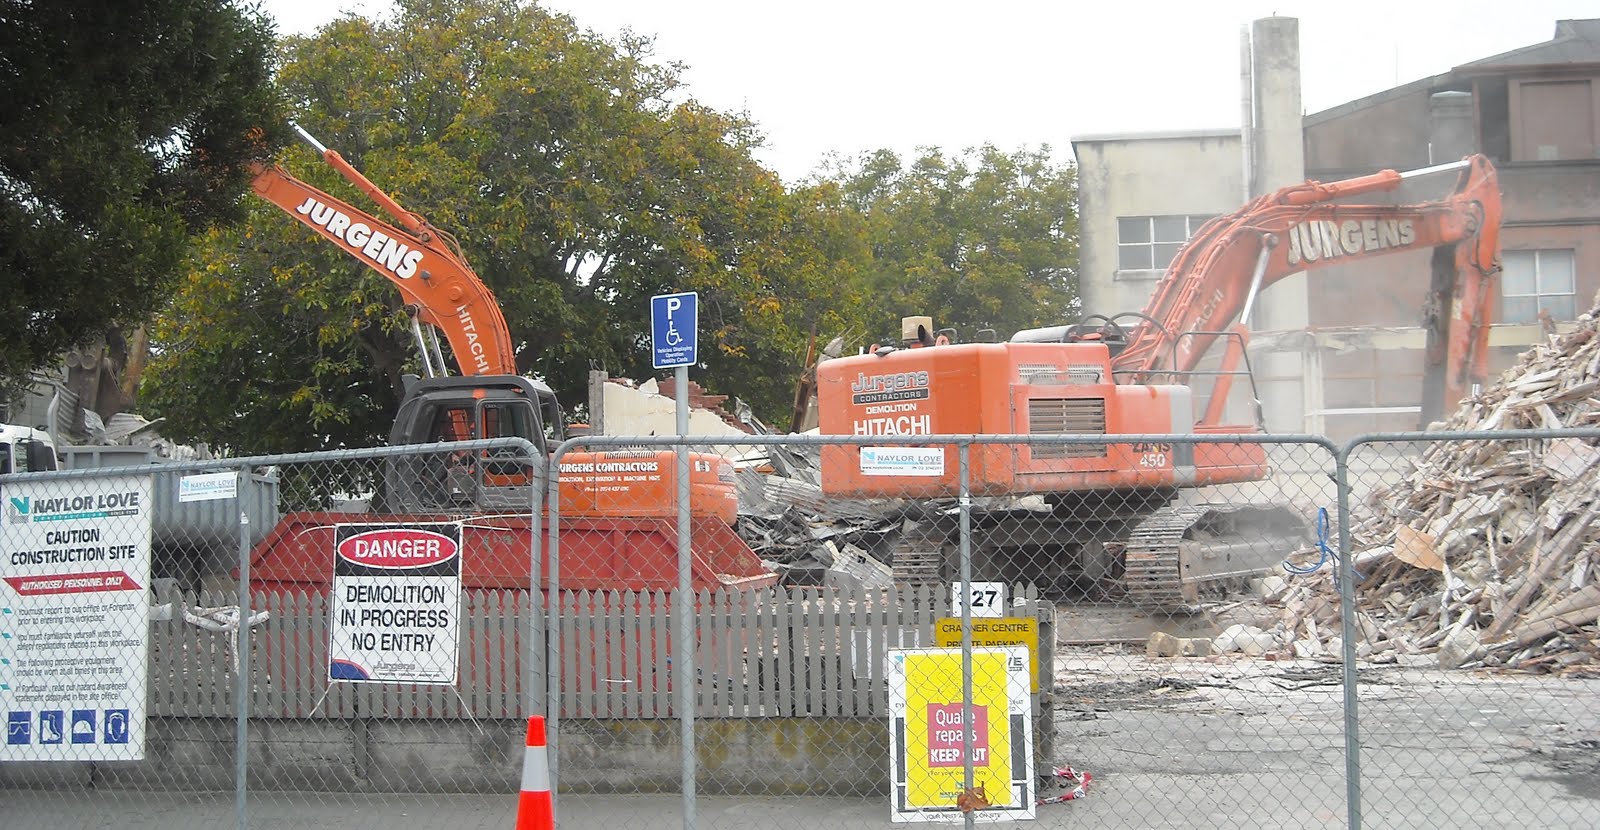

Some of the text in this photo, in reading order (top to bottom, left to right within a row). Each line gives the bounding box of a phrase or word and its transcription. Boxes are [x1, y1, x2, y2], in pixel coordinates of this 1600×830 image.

[295, 197, 425, 280] JURGENS
[1287, 219, 1416, 265] JURGENS
[667, 297, 682, 320] P
[456, 304, 491, 374] HITACHI
[851, 370, 930, 393] Jurgens
[860, 391, 922, 402] CONTRACTORS
[866, 403, 917, 414] DEMOLITION
[853, 415, 931, 436] HITACHI
[559, 462, 659, 473] URGENS CONTRACTORS
[1139, 453, 1166, 468] 450
[190, 480, 216, 488] NAYLOR
[34, 492, 140, 514] NAYLOR LOVE
[46, 528, 101, 545] CAUTION
[11, 545, 136, 565] CONSTRUCTION SITE
[354, 539, 441, 558] DANGER
[20, 575, 125, 591] AUTHORISED PERSONNEL ONLY
[346, 585, 445, 604] DEMOLITION
[341, 609, 449, 628] IN PROGRESS
[991, 623, 1029, 632] CENTRE
[352, 633, 436, 652] NO ENTRY
[935, 730, 978, 746] repas
[930, 748, 960, 763] KEEP
